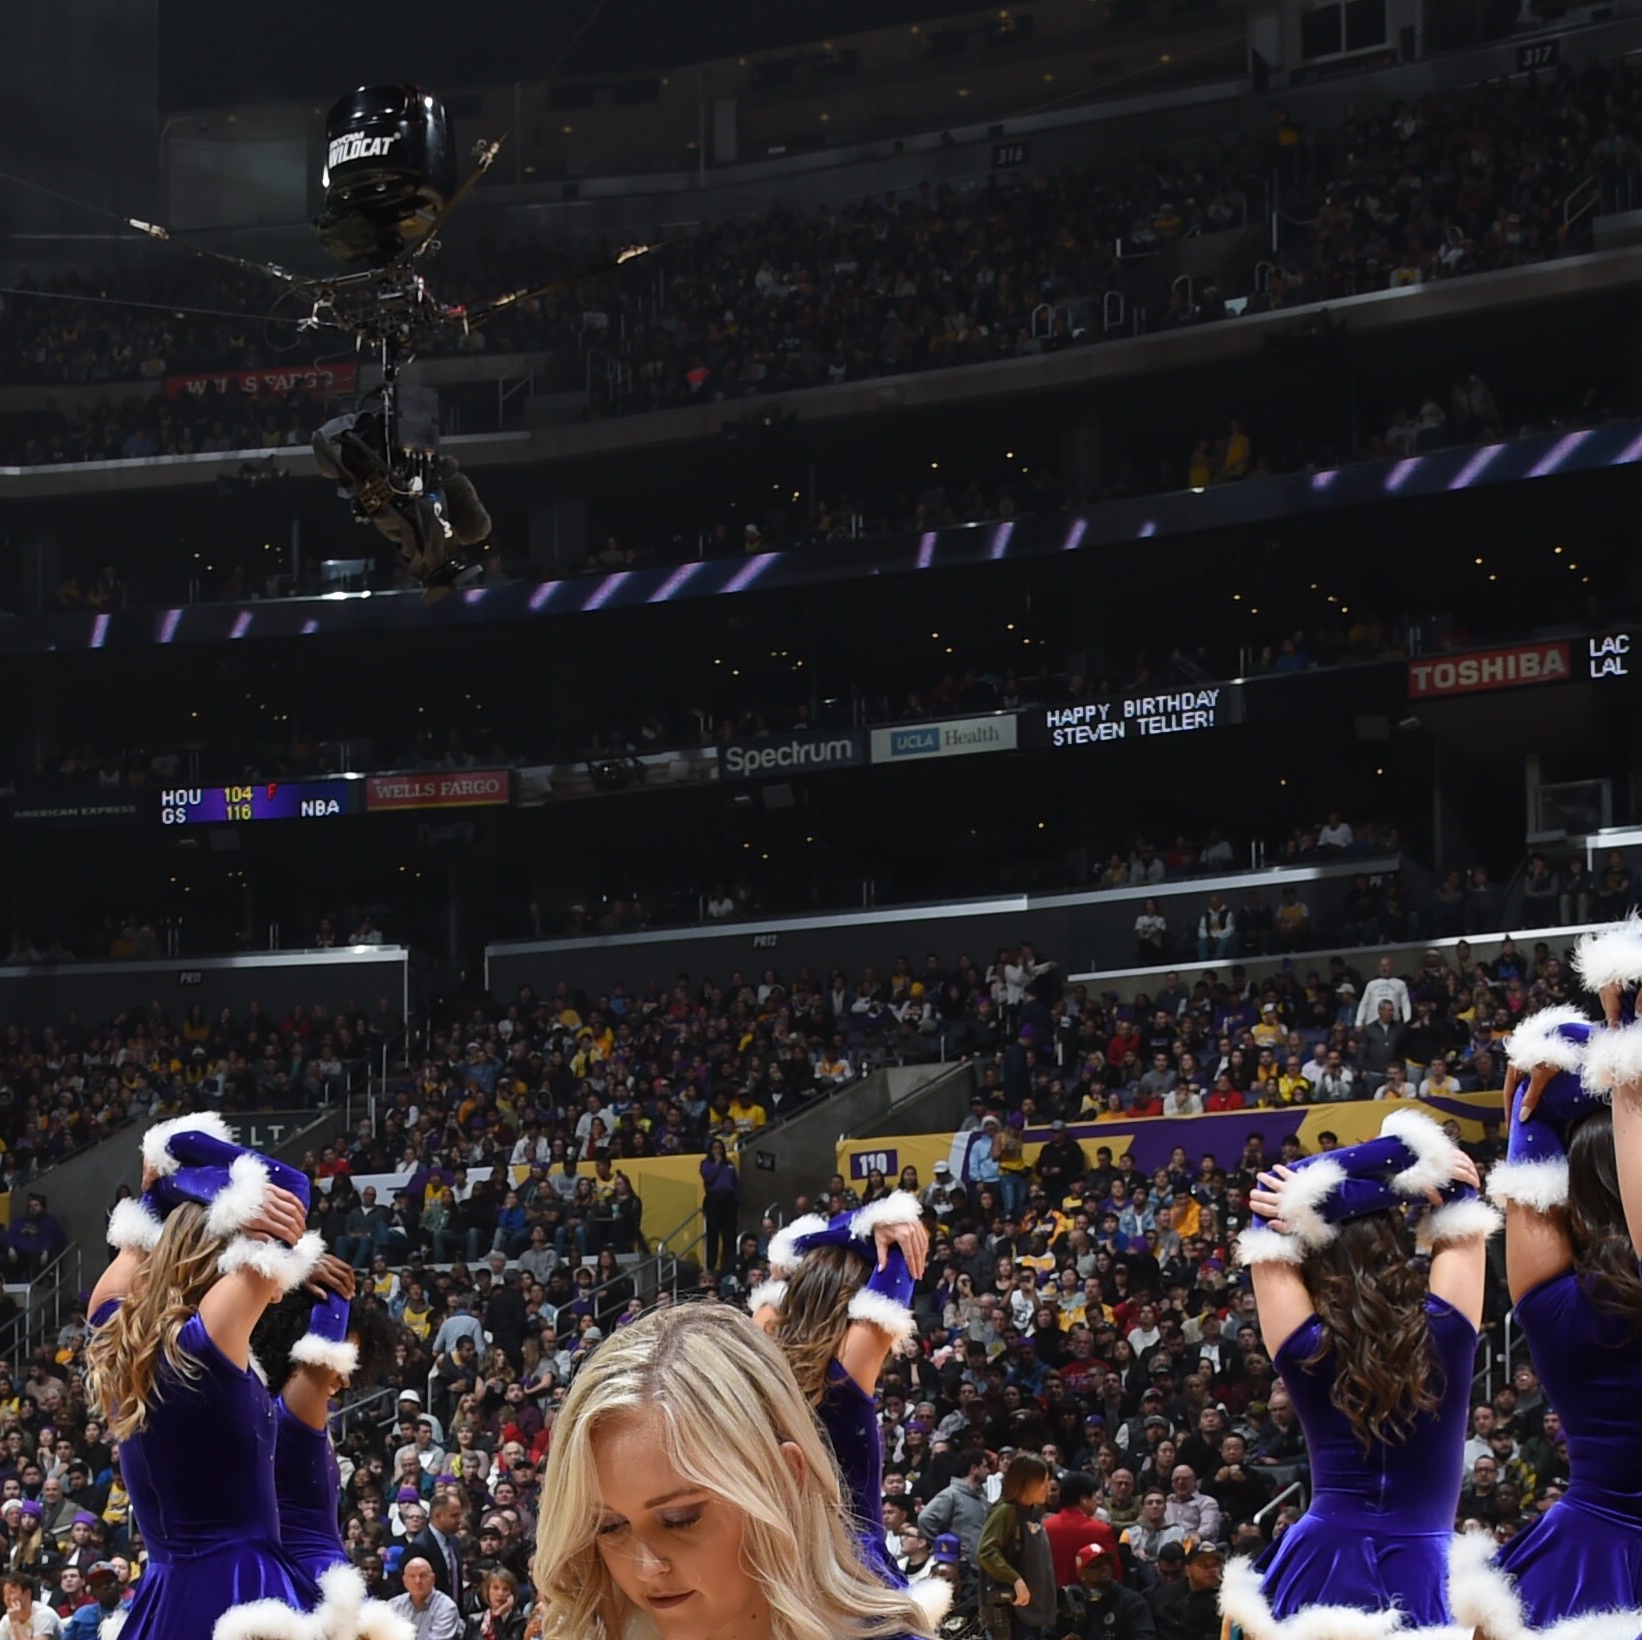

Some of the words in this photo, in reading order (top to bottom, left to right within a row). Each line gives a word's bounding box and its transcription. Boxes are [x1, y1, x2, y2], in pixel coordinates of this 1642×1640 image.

[328, 137, 394, 170] WILDCAT
[1589, 634, 1630, 657] LAC
[1411, 648, 1565, 691] TOSHIBA
[1589, 656, 1629, 679] LAL
[1046, 702, 1110, 728] HAPPY
[1122, 689, 1220, 719] BIRTHDAY
[897, 734, 934, 750] UCLA
[944, 726, 1000, 746] Health
[1052, 720, 1125, 747] STEVEN
[1136, 709, 1215, 736] TELLER!
[726, 738, 852, 776] Spectrum
[161, 788, 202, 806] HOU
[223, 785, 253, 803] 104
[267, 782, 278, 800] F
[375, 782, 436, 799] WELLS
[441, 779, 500, 796] FARGO
[13, 807, 79, 819] AMERICAN
[81, 804, 137, 816] EXPRESS
[161, 808, 187, 825] GS
[300, 800, 340, 818] NBA
[859, 1152, 887, 1177] 110
